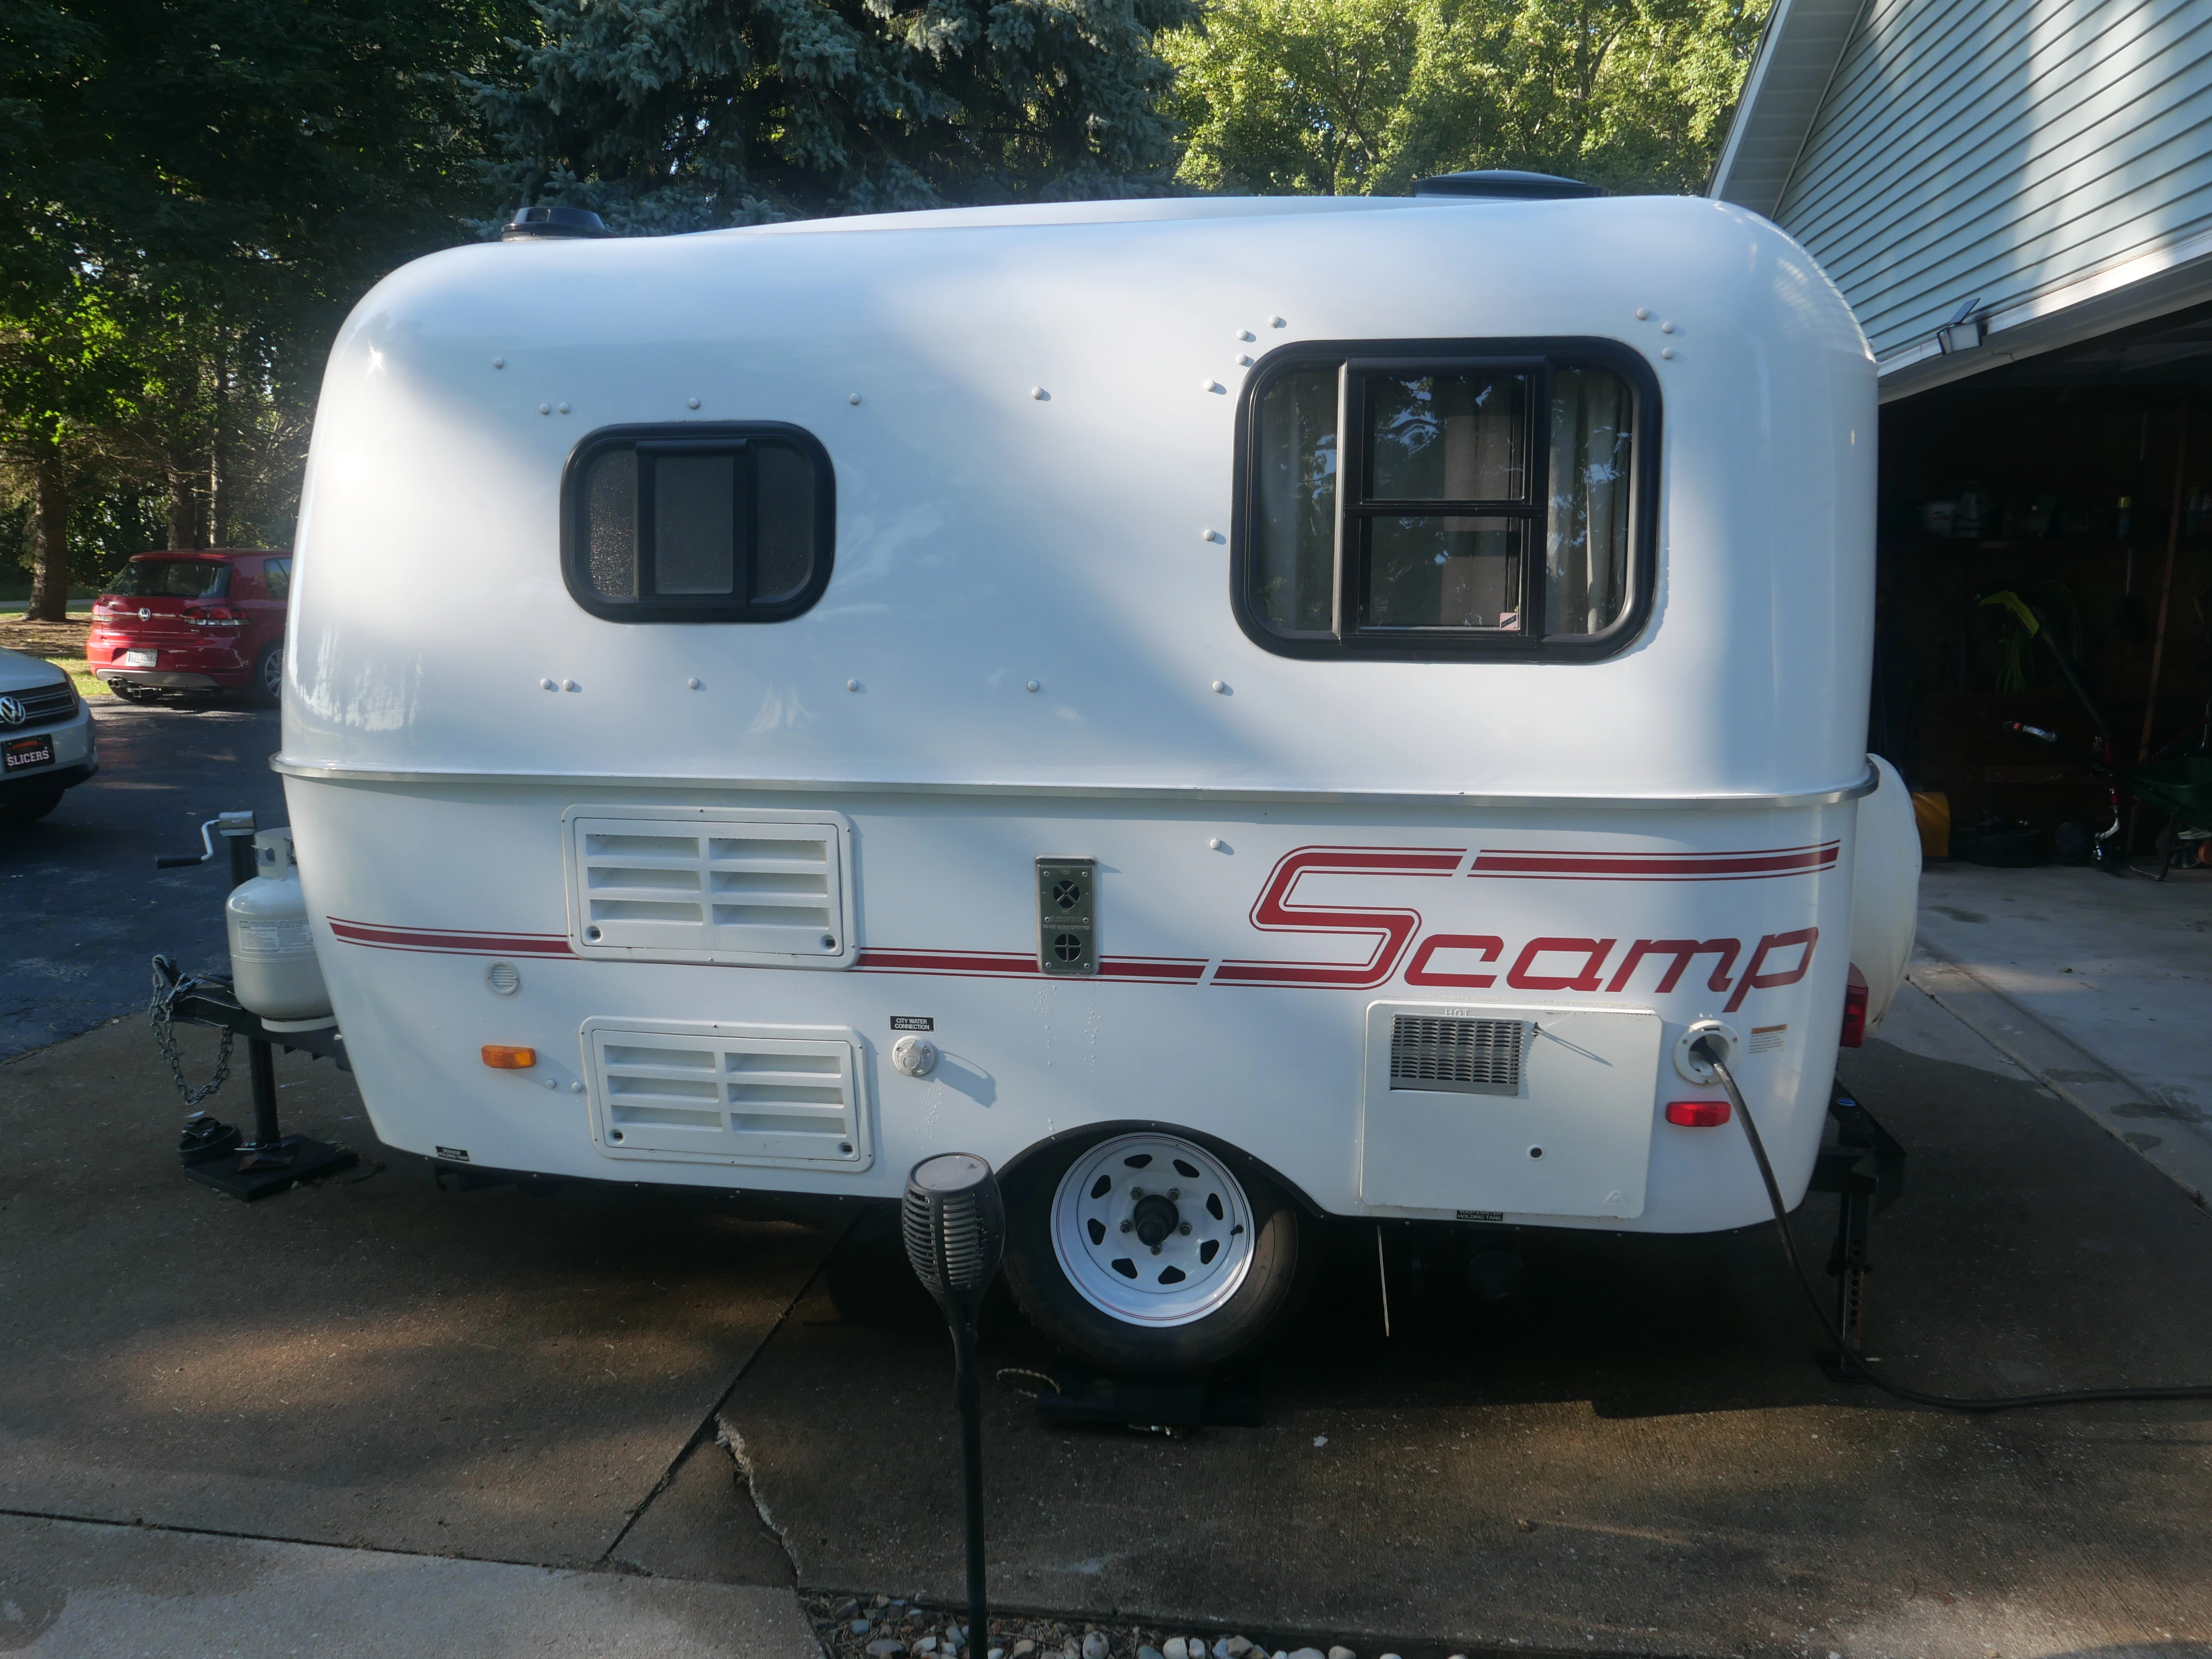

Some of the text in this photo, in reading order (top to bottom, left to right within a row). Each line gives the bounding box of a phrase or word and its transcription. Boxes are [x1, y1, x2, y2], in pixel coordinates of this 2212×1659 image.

[1502, 617, 1515, 627] HEHR
[7, 750, 50, 766] SLICERS
[1210, 845, 1819, 1013] Scamp
